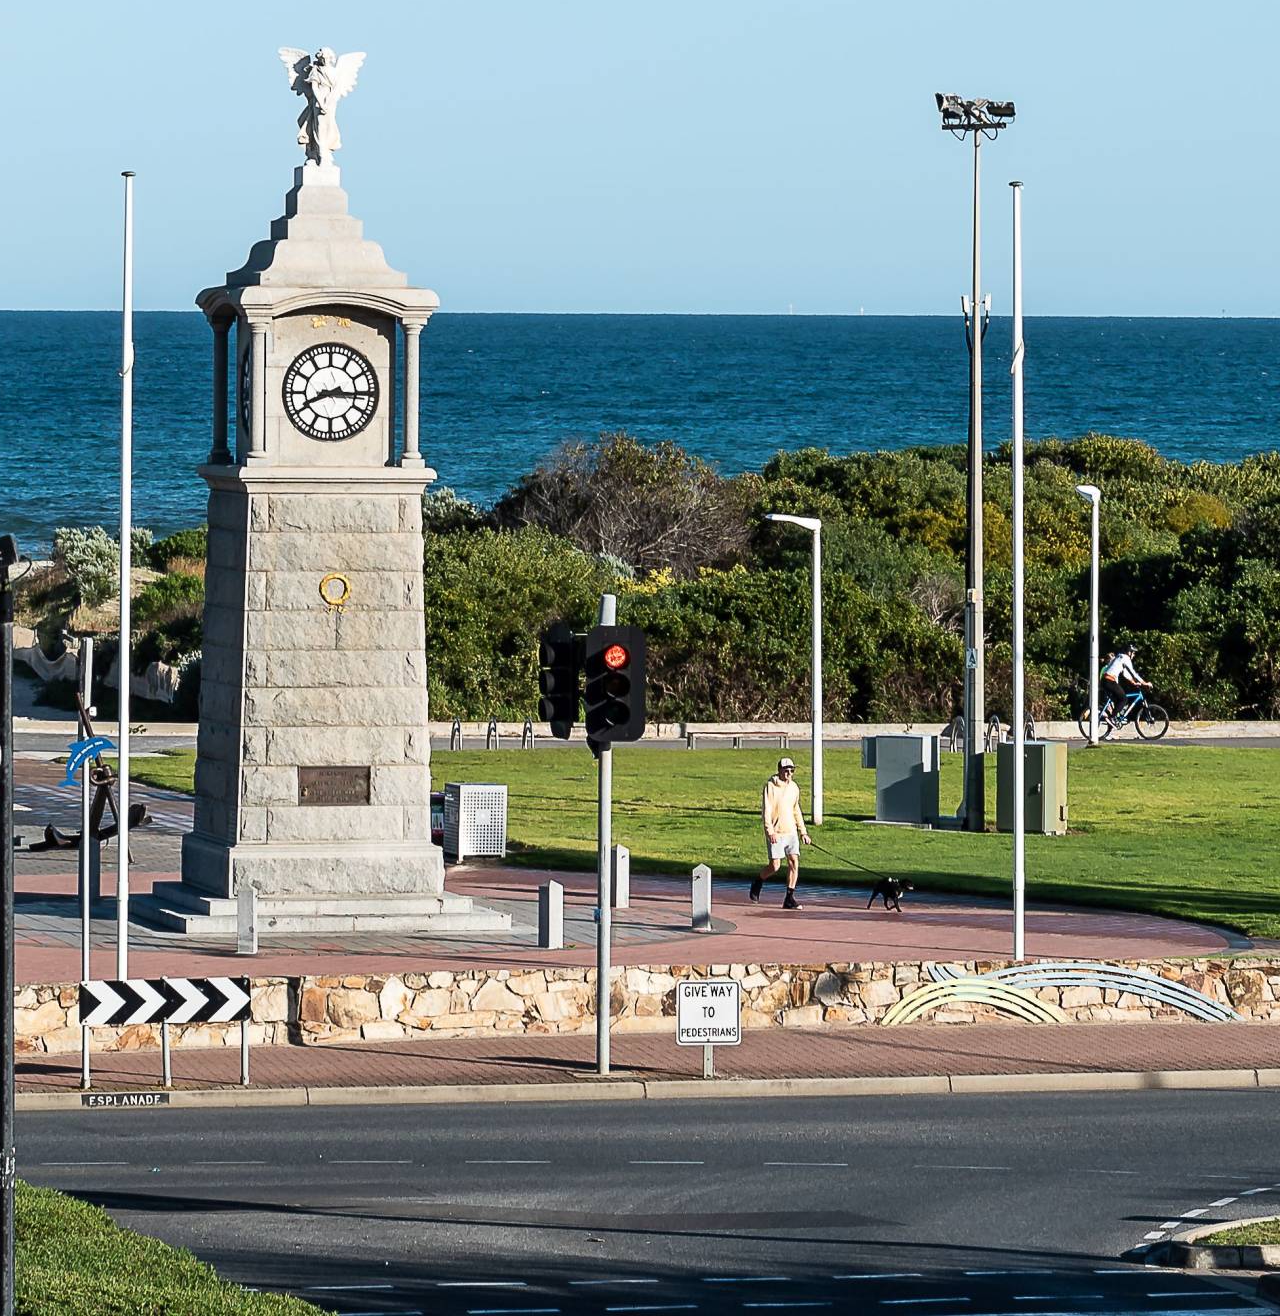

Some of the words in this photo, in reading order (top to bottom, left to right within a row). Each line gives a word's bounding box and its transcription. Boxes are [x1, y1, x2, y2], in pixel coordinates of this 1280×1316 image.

[684, 986, 708, 997] GIVE
[710, 986, 733, 997] WAY
[702, 1006, 715, 1018] TO
[681, 1027, 737, 1037] PEDESTRIANS
[89, 1095, 161, 1106] ESPLANADE
